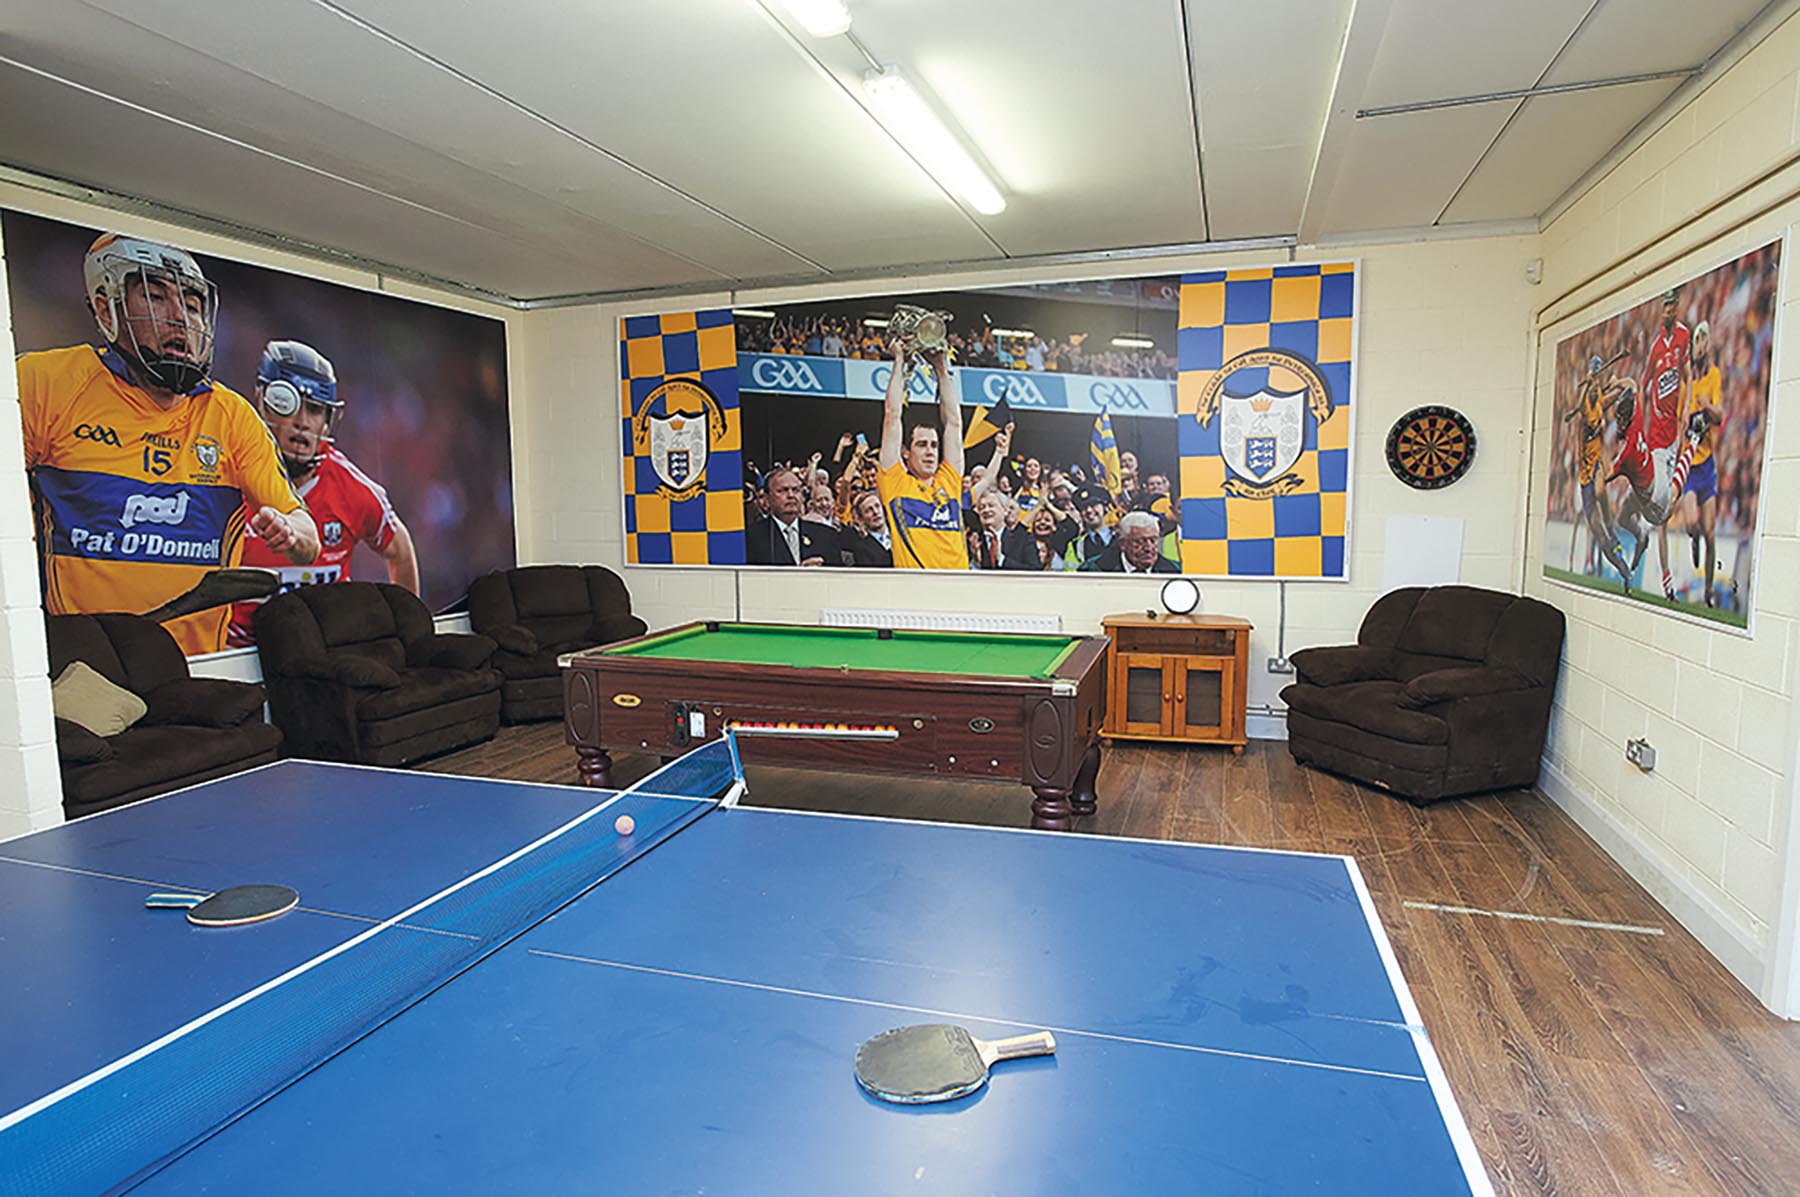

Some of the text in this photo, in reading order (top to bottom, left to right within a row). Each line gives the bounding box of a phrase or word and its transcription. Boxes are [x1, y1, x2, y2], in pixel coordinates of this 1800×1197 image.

[752, 357, 823, 391] GAA
[871, 367, 934, 396] GA
[983, 373, 1048, 406] GAA
[1089, 381, 1149, 410] GAA
[143, 445, 172, 477] 15
[71, 527, 221, 560] Pat O'Donnell
